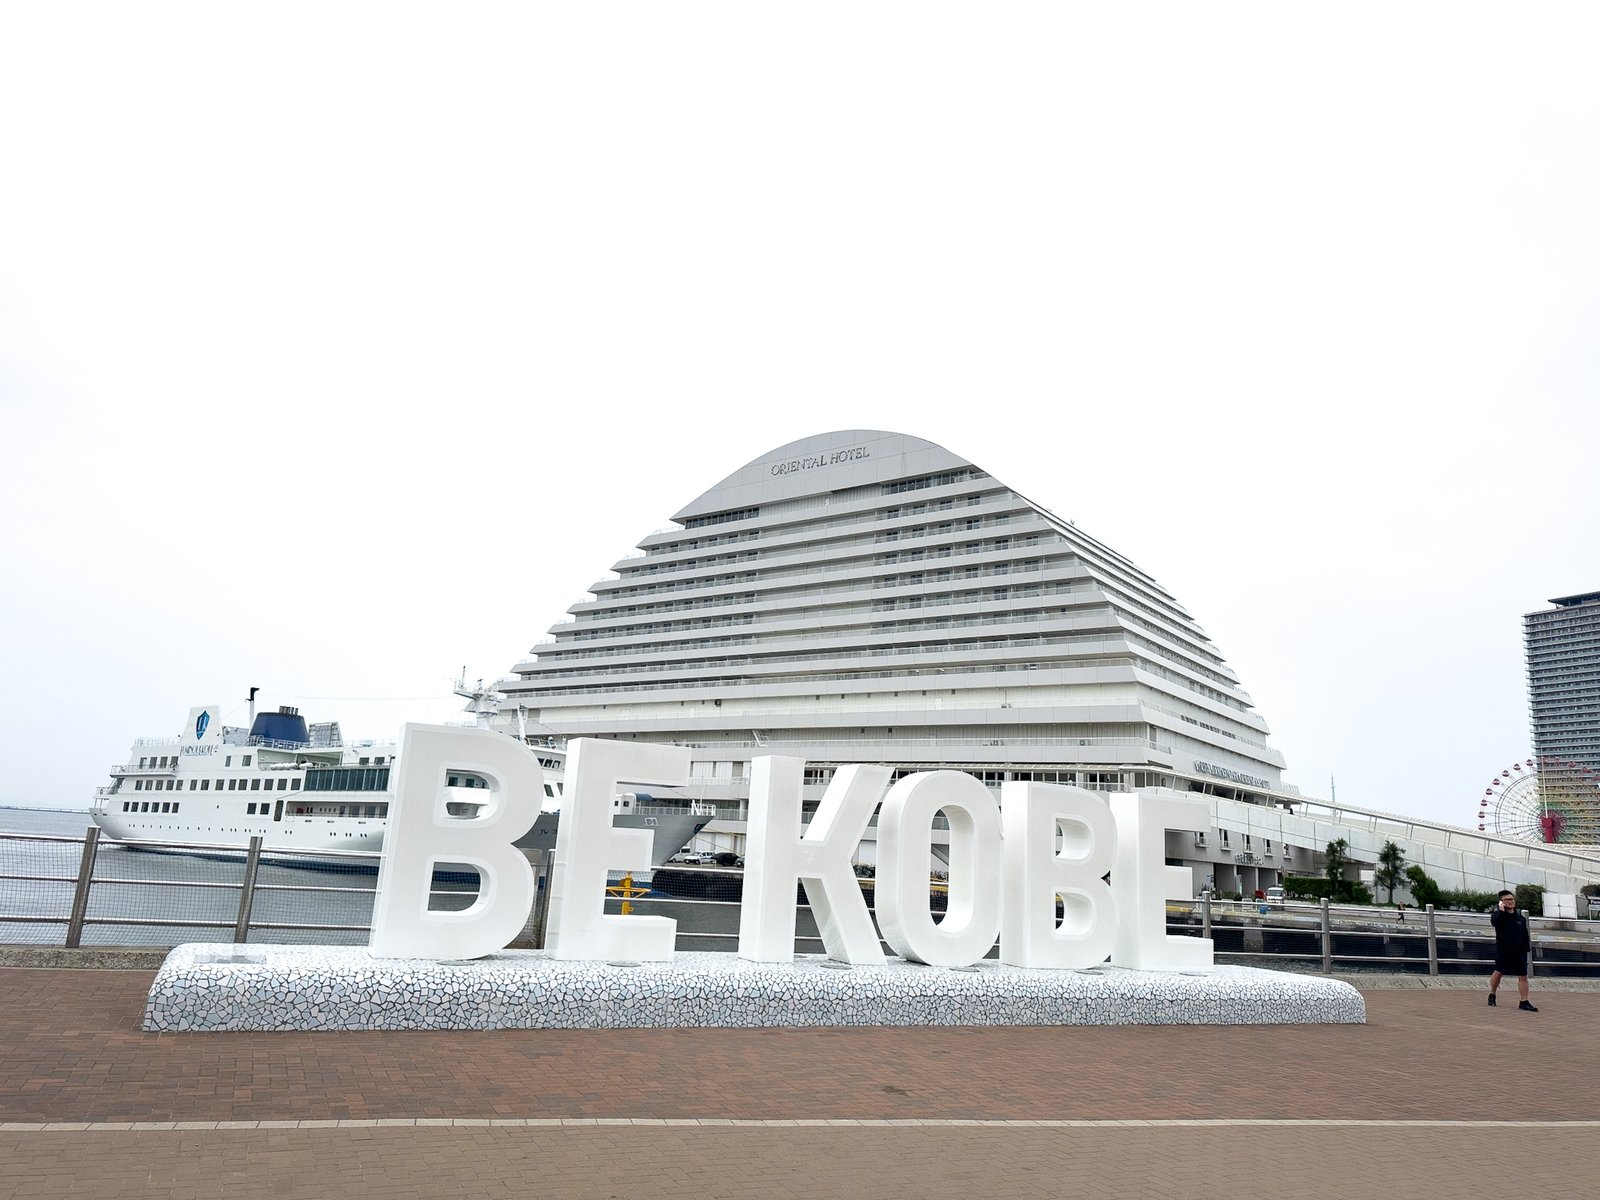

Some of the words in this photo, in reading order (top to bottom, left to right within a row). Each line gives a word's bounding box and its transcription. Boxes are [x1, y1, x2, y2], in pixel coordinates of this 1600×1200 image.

[771, 455, 827, 476] ORIENTAL
[830, 447, 870, 465] HOTEL
[368, 722, 693, 962] BE
[737, 754, 1215, 971] KOBE
